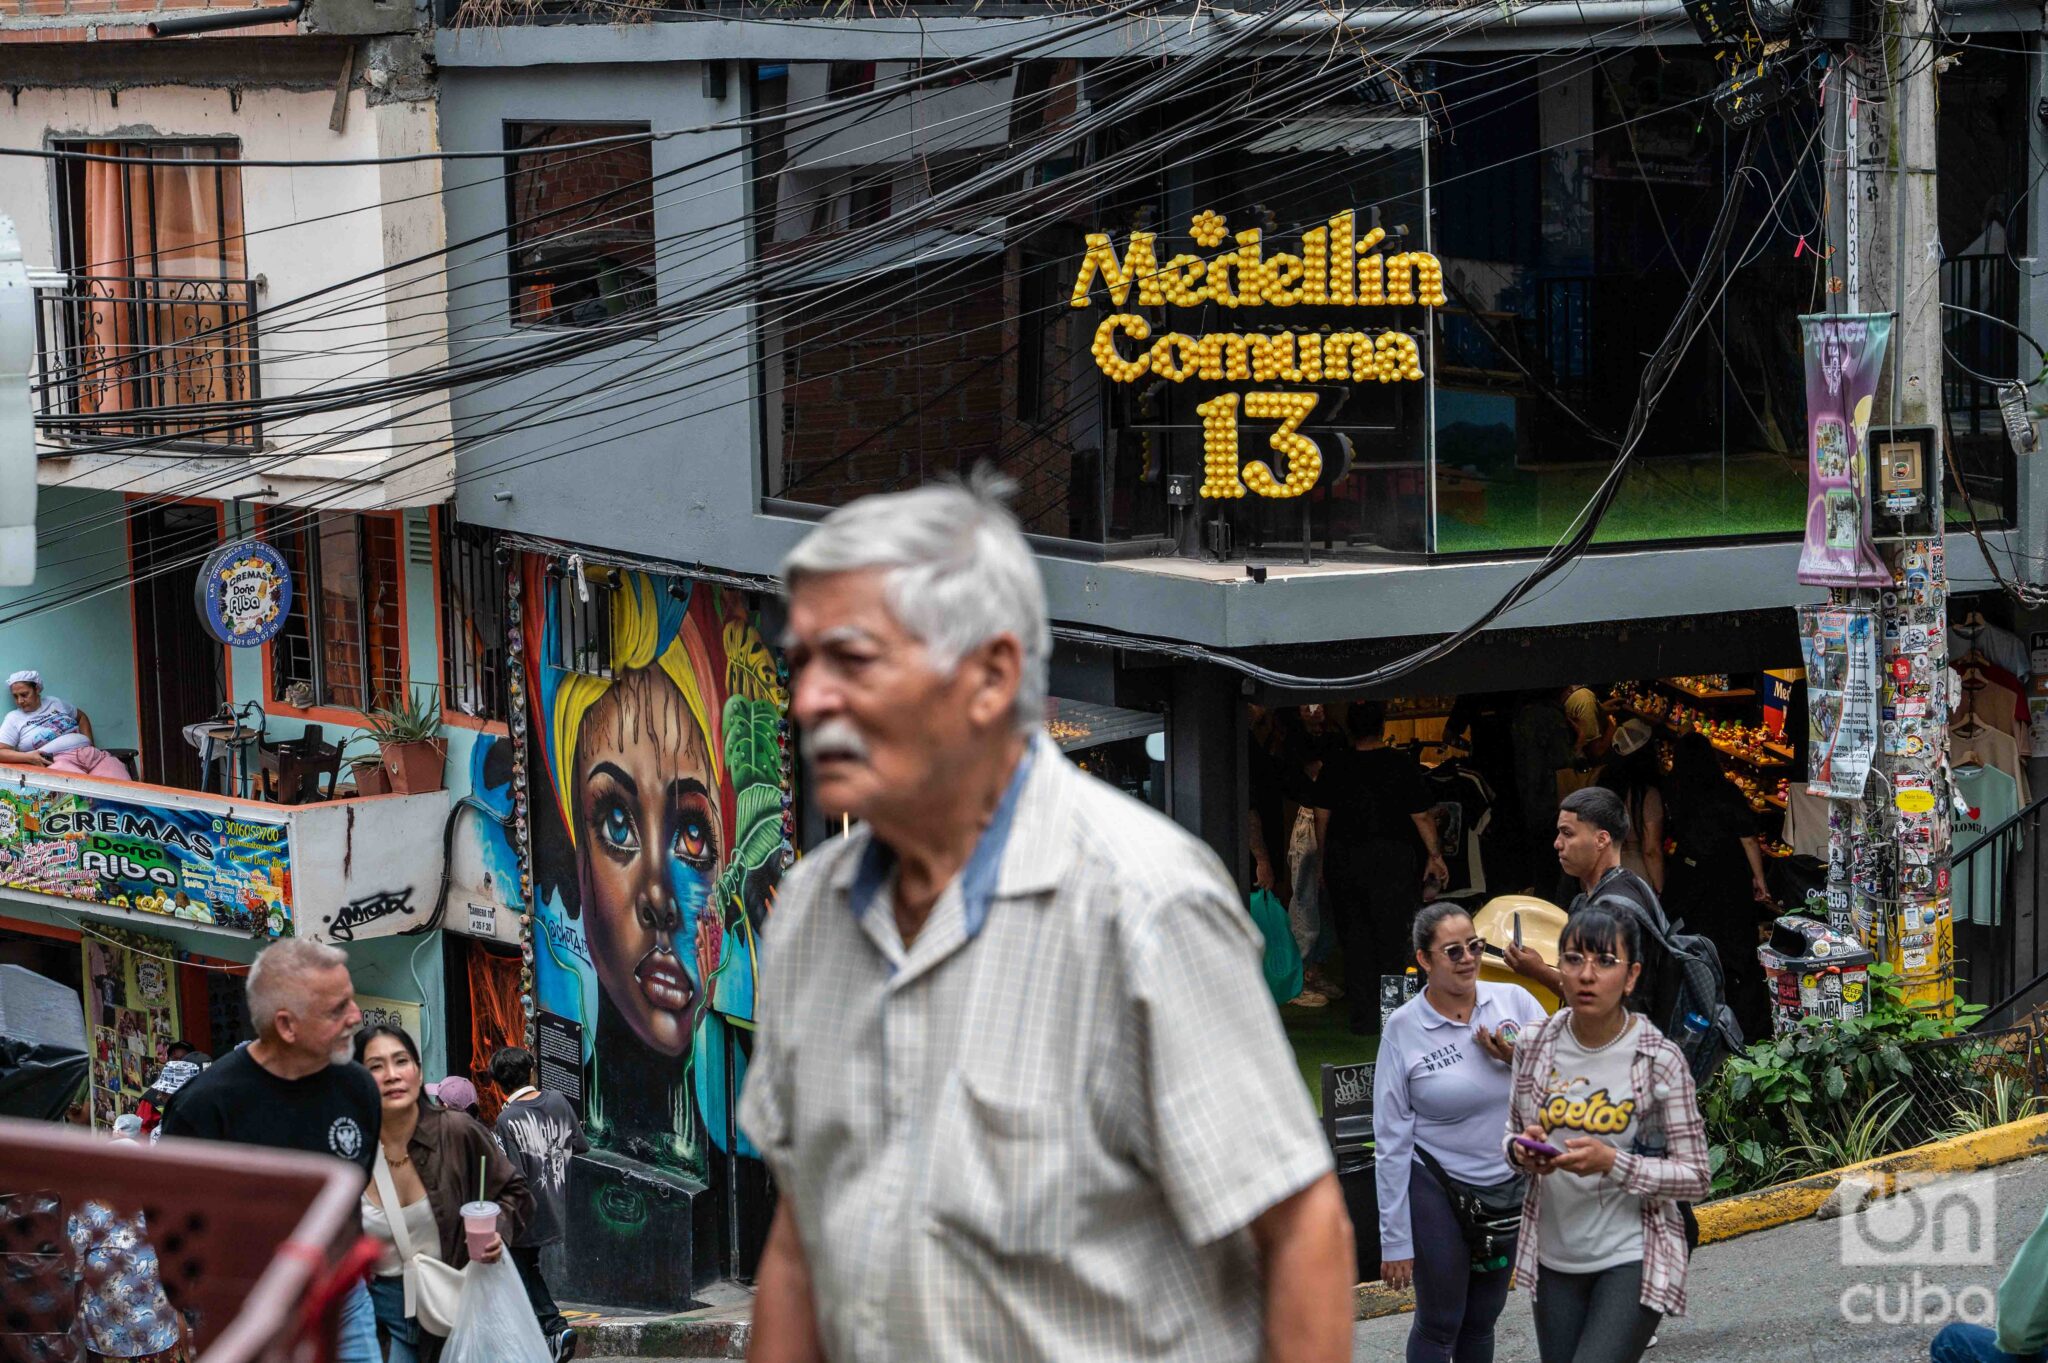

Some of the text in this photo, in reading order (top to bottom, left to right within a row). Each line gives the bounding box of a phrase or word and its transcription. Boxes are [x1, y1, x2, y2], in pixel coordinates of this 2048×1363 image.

[1070, 208, 1449, 309] Medellín
[1091, 313, 1425, 384] Comuna
[1196, 392, 1323, 500] 13
[212, 545, 243, 579] ORIGINALES
[265, 547, 286, 570] COMUNA
[229, 570, 268, 587] CREMAS
[233, 584, 256, 596] Doña
[229, 595, 260, 616] Alba
[43, 811, 214, 861] CREMAS
[92, 836, 163, 861] Doña
[81, 850, 178, 888] Alba
[1422, 1042, 1459, 1064] KELLY
[1425, 1052, 1464, 1073] MARIN
